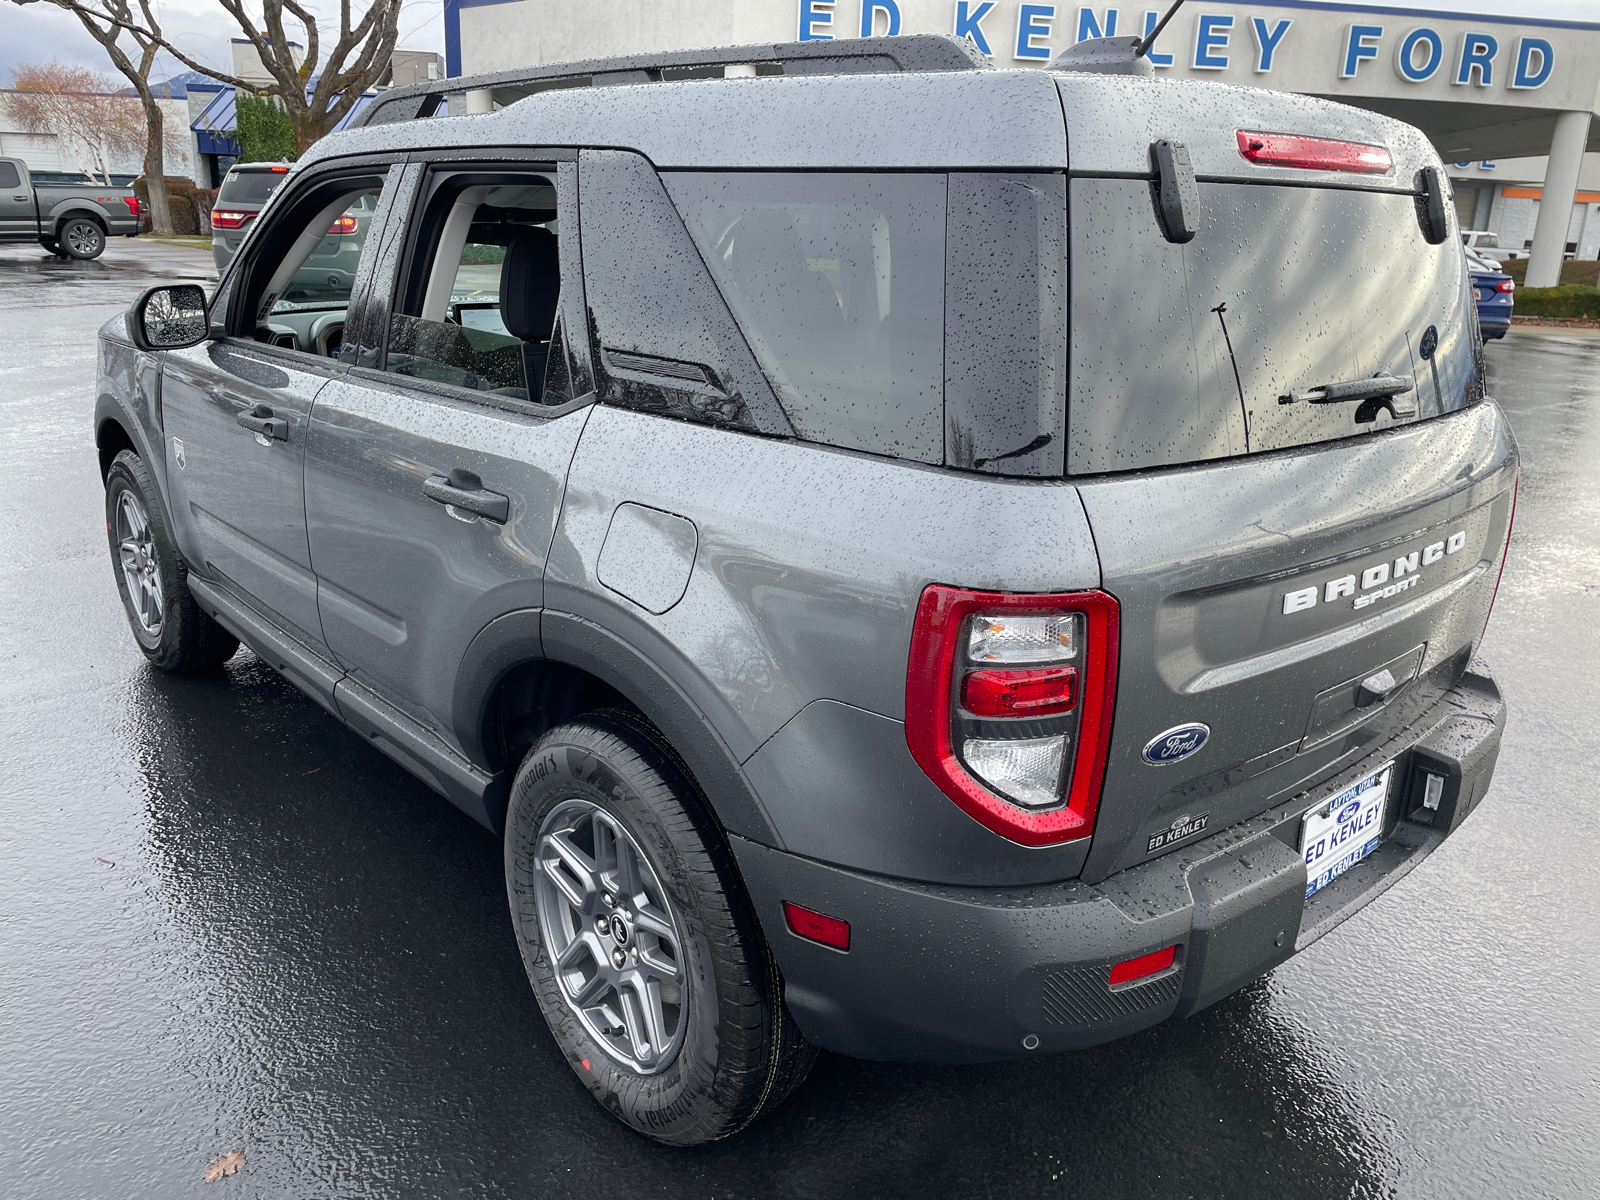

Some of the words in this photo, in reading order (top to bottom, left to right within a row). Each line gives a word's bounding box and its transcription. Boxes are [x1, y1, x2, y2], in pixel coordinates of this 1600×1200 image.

[798, 0, 903, 41] ED
[954, 0, 1294, 74] KENLEY
[1338, 24, 1555, 90] FORD
[1282, 530, 1466, 615] BRONCO
[1352, 574, 1421, 610] SPORT
[1160, 732, 1199, 758] Ford
[1358, 775, 1377, 795] UTAH
[1340, 803, 1358, 822] Ford
[1148, 835, 1164, 850] ED
[1166, 816, 1209, 842] KENLEY
[1306, 838, 1326, 864] ED
[1330, 800, 1382, 850] KENLEY
[1315, 870, 1330, 890] ED
[1331, 846, 1364, 878] KENLEY
